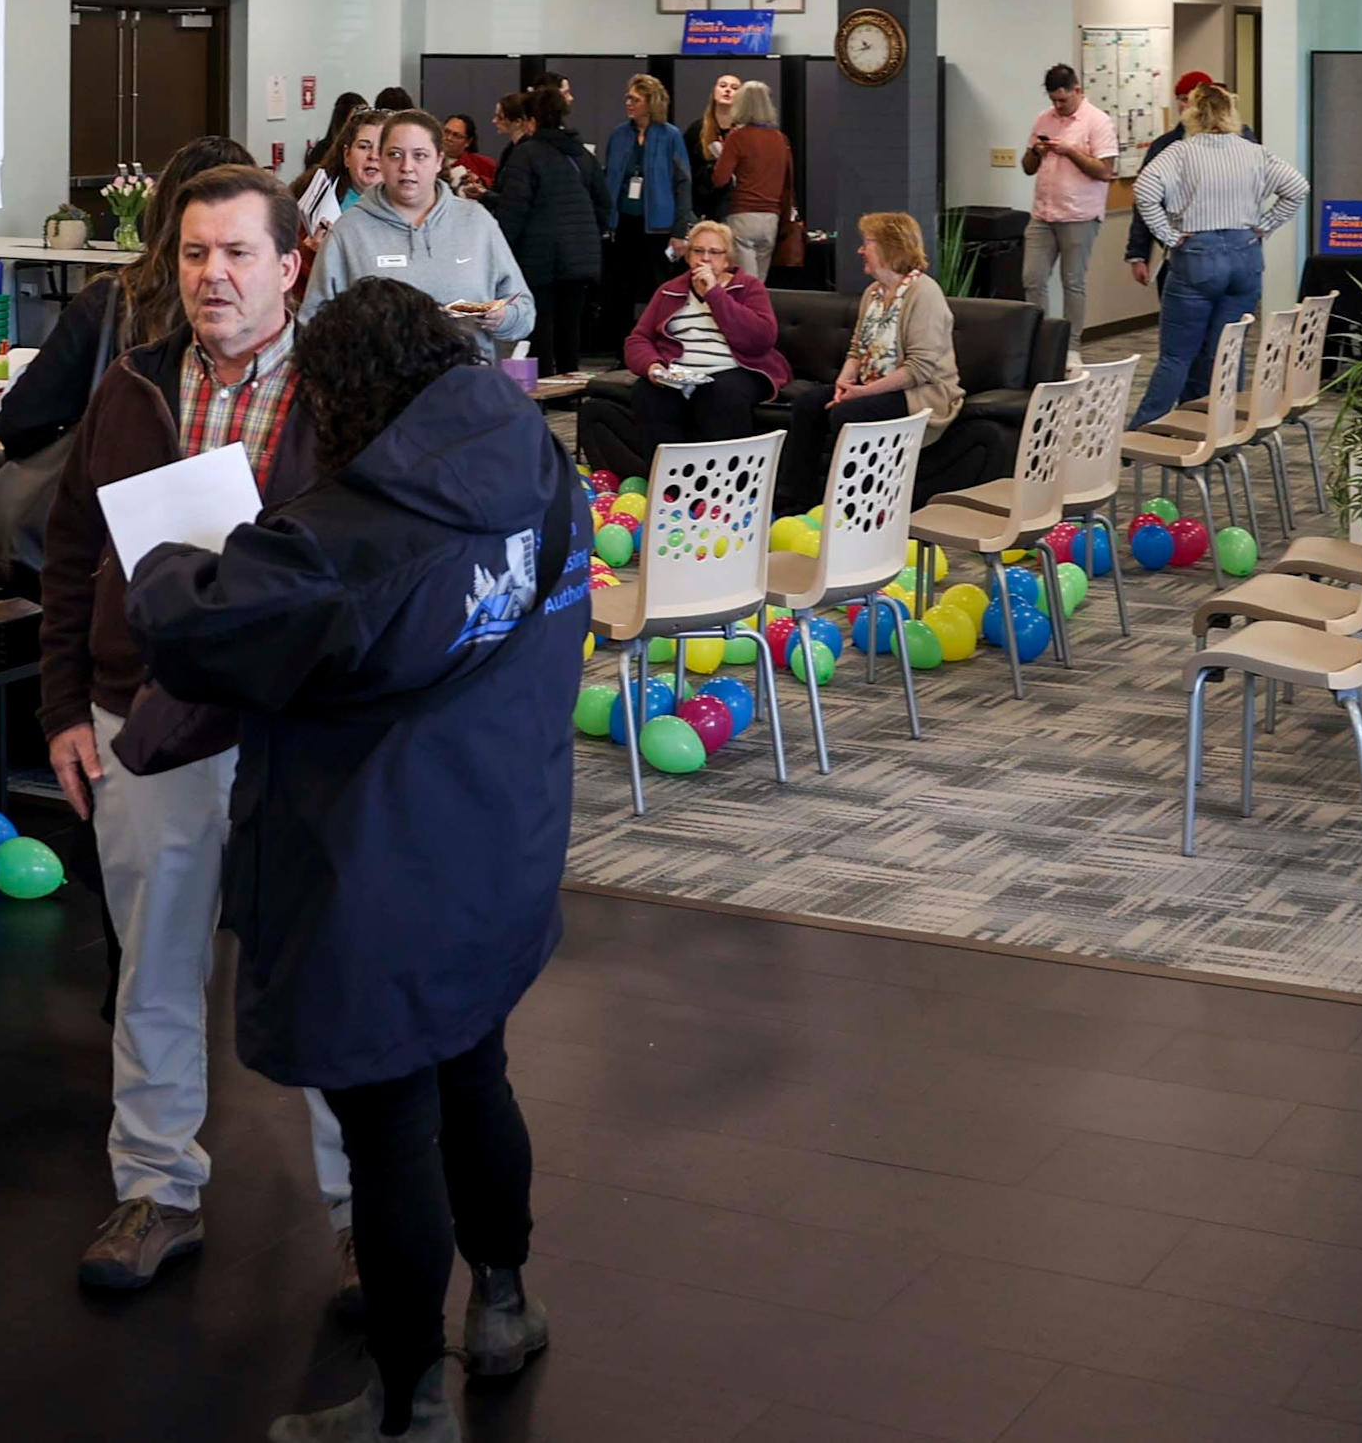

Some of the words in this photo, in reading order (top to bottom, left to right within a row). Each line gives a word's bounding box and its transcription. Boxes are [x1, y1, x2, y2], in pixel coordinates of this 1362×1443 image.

[689, 25, 720, 33] ARCHES
[721, 25, 748, 34] Family
[687, 36, 707, 44] How
[709, 36, 719, 44] to
